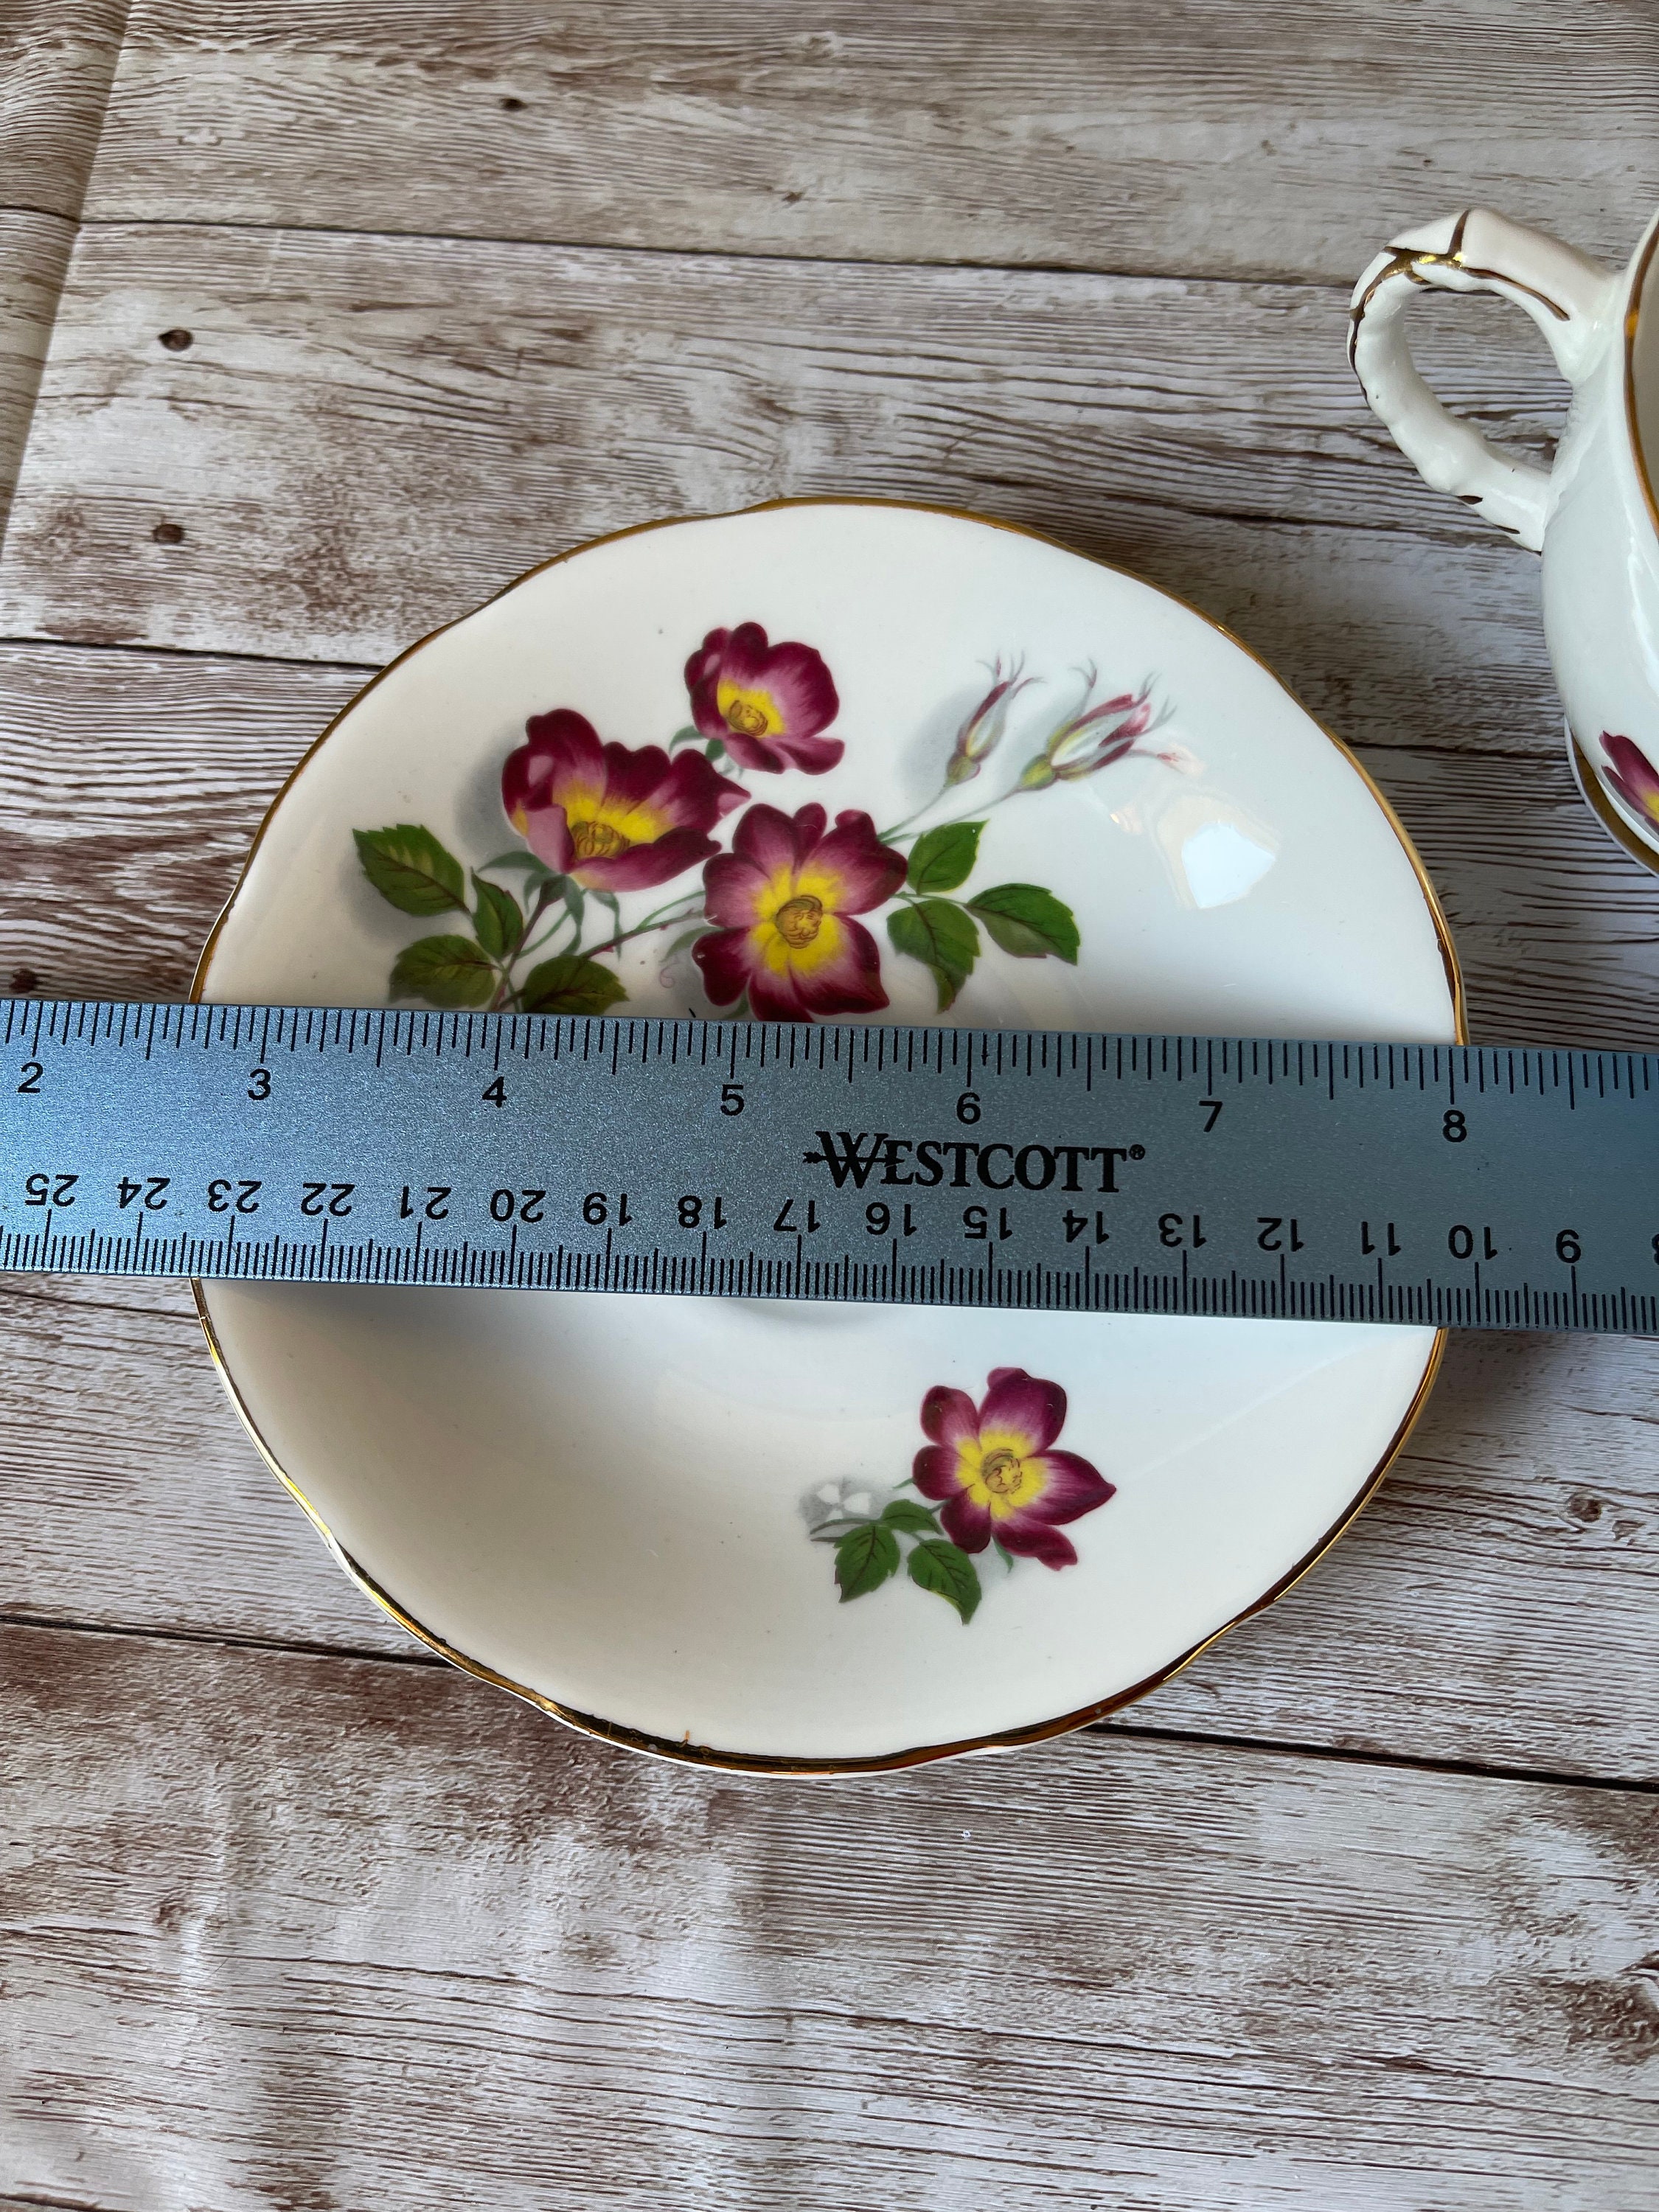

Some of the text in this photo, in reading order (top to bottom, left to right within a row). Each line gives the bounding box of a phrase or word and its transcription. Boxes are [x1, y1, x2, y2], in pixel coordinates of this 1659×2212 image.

[17, 1062, 1467, 1143] 2 3 4 5 6 7 8
[24, 1173, 1582, 1264] 25 24 23 22 21 20 19 18 17 16 15 14 13 12 11 10 9
